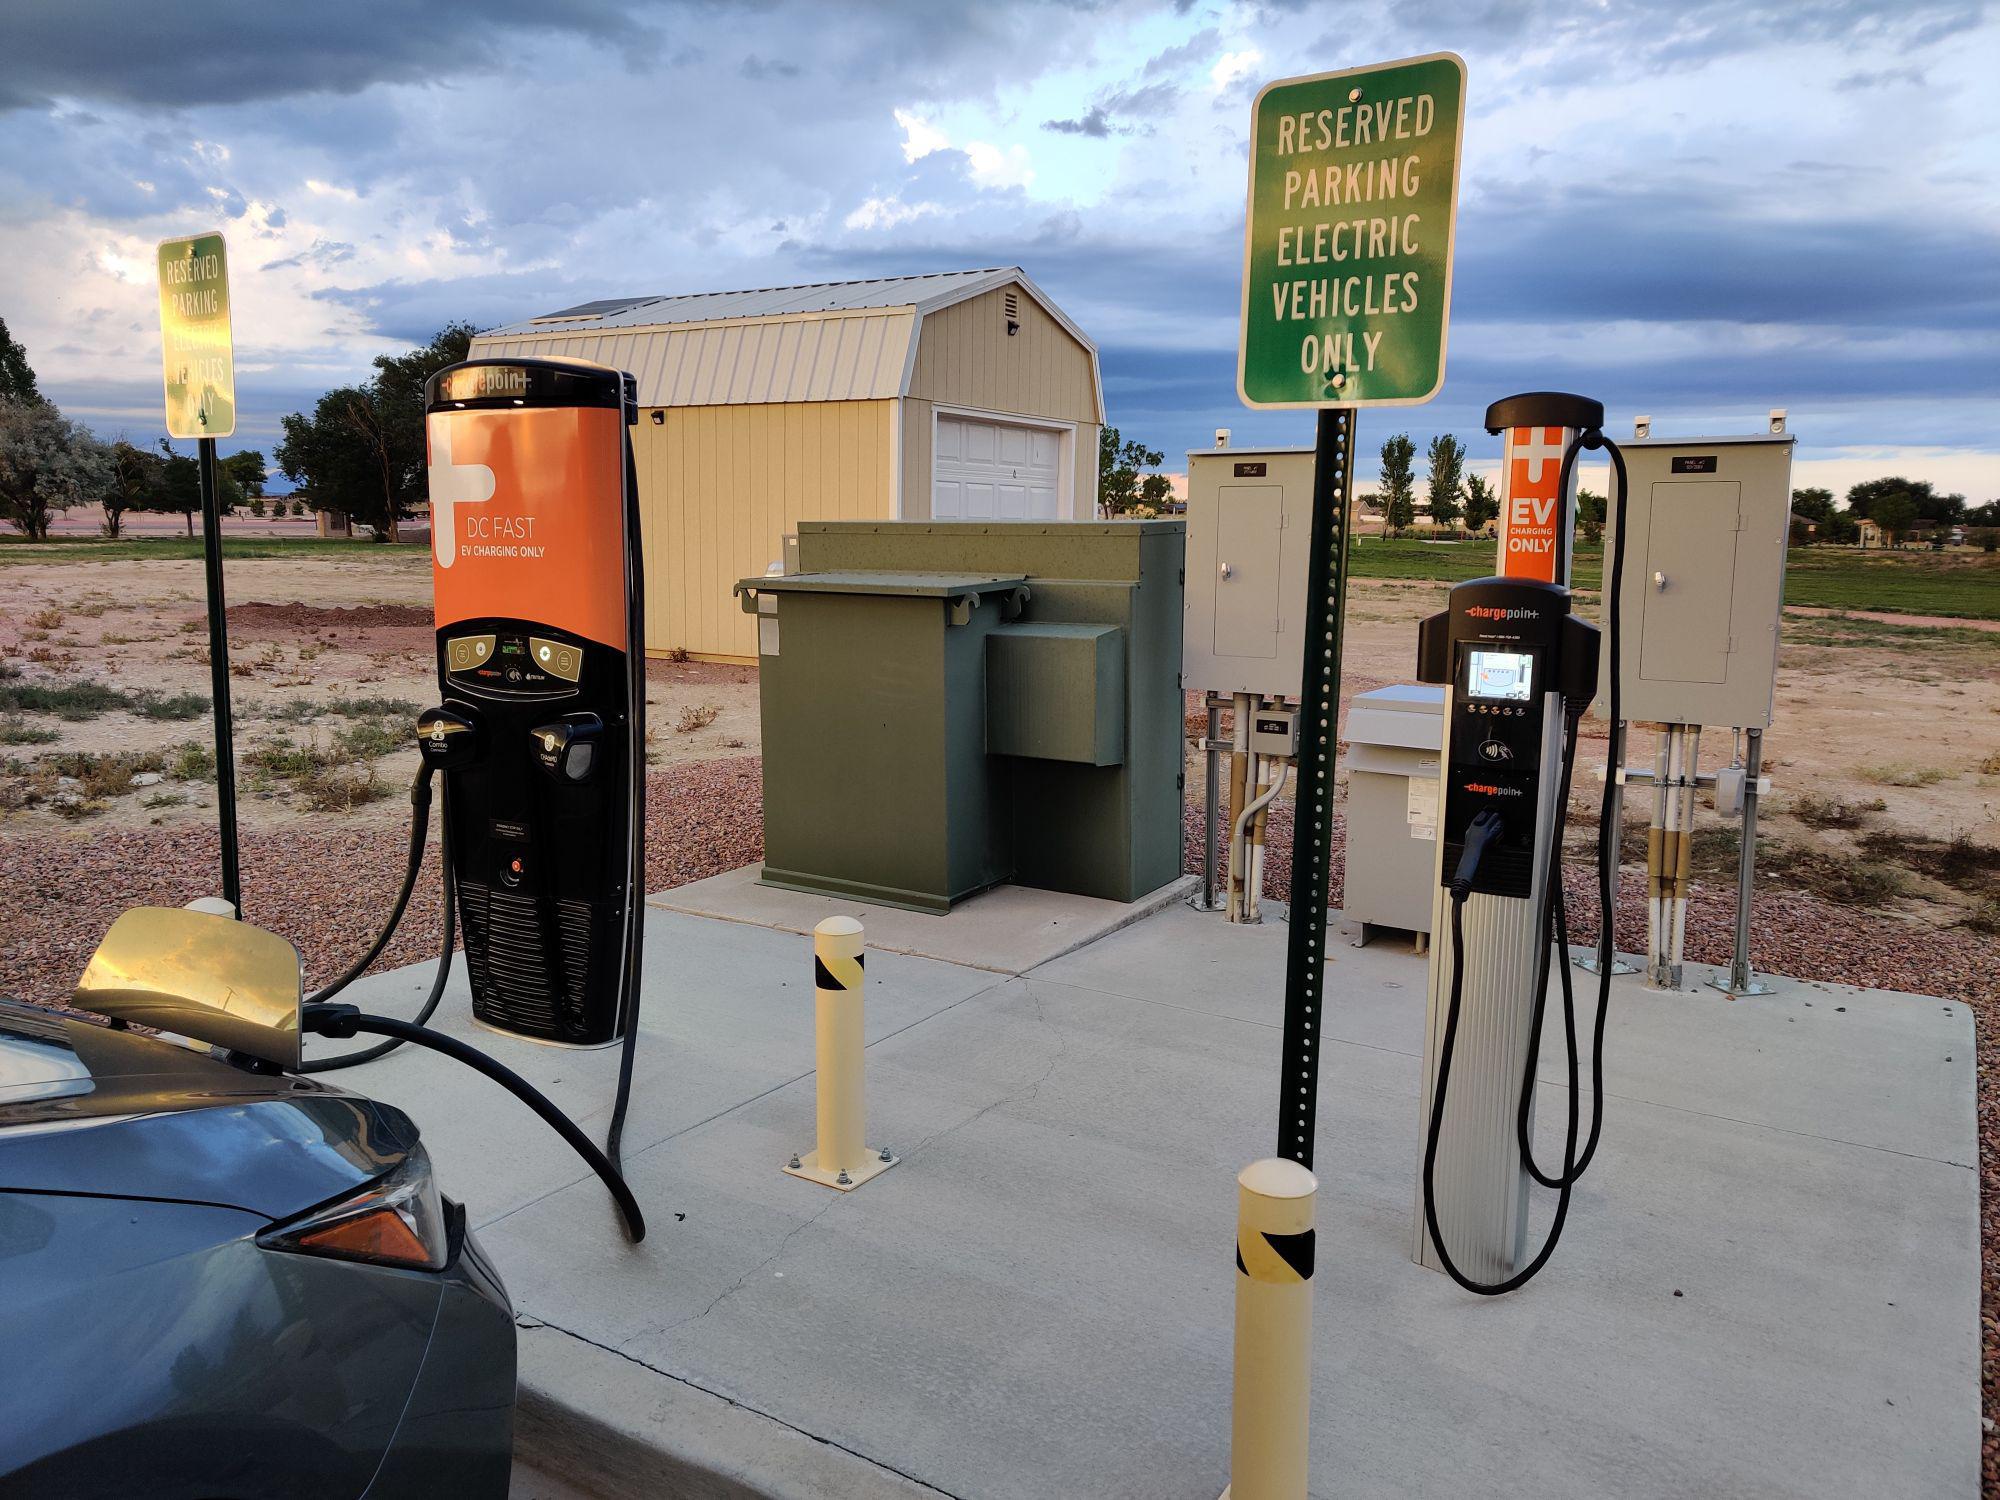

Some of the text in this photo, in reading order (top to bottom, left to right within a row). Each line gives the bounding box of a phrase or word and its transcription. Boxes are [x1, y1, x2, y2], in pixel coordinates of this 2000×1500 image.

[1278, 94, 1435, 155] RESERVED
[1284, 155, 1421, 210] PARKING
[1277, 213, 1421, 267] ELECTRIC
[166, 254, 219, 285] RESERVED
[172, 288, 219, 317] PARKING
[1272, 271, 1420, 321] VEHICLES
[1301, 331, 1383, 374] ONLY
[175, 357, 224, 385] VEHICLES
[1511, 497, 1556, 525] EV
[467, 517, 536, 538] DC FAST
[1510, 527, 1553, 535] CHARGING
[461, 545, 545, 558] EV CHARGING ONLY
[1509, 538, 1553, 553] ONLY
[428, 741, 448, 749] Combo
